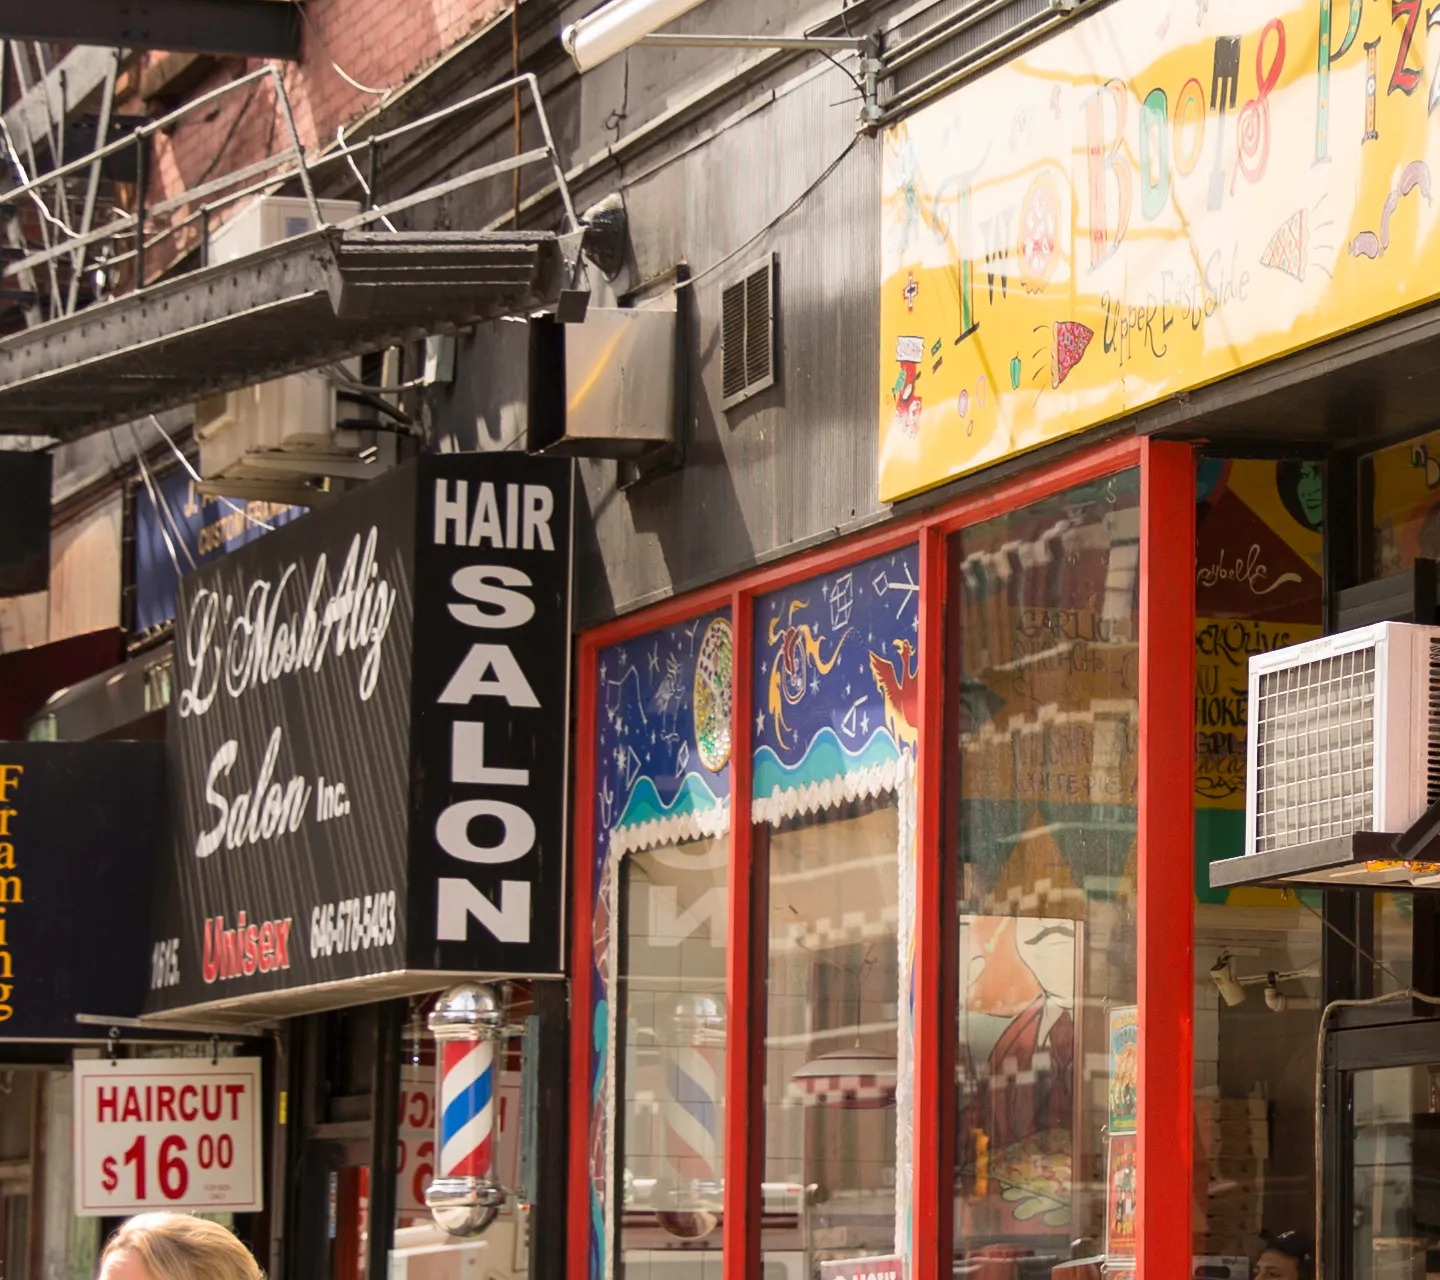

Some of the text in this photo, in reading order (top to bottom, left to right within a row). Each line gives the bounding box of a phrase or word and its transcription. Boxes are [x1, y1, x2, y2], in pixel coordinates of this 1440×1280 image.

[433, 478, 555, 551] HAIR
[195, 726, 350, 858] Salon Inc.
[435, 564, 542, 945] SALON
[201, 910, 293, 984] Unisex
[310, 890, 397, 959] 646-678-5493
[97, 1083, 245, 1122] HAIRCUT
